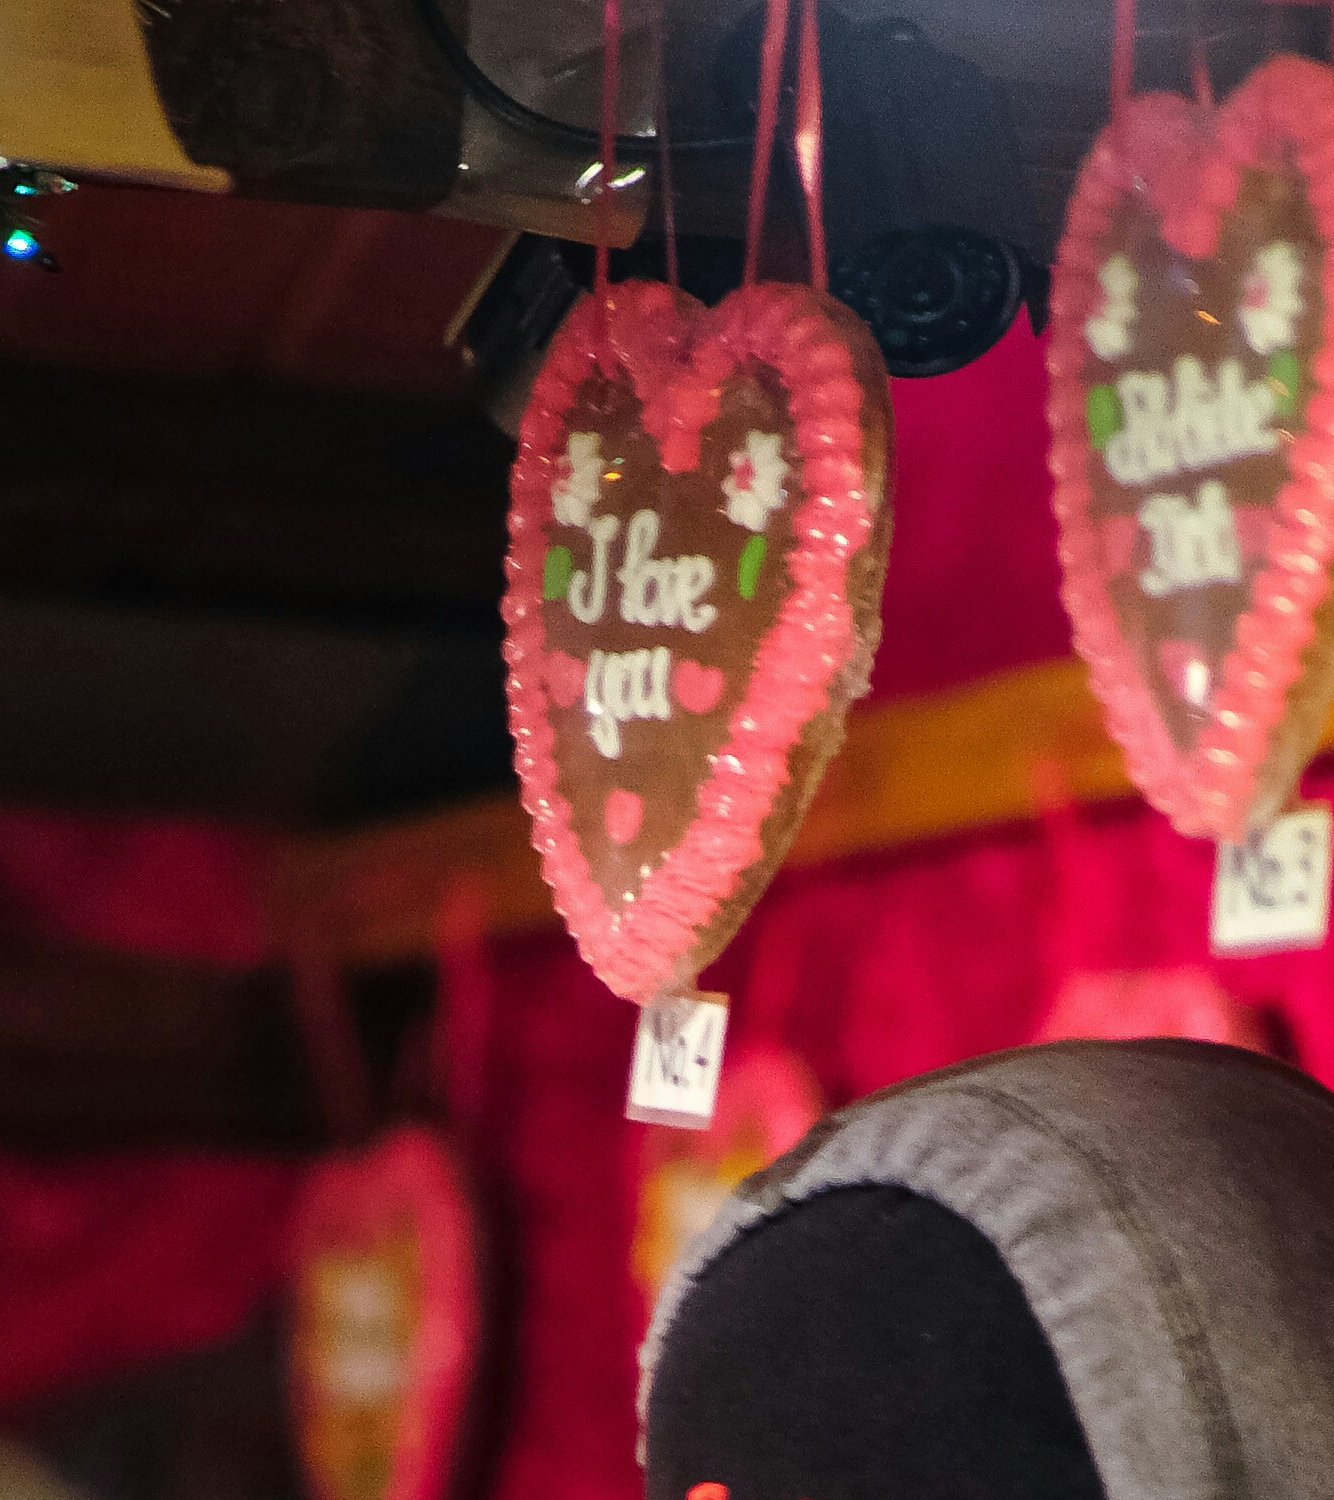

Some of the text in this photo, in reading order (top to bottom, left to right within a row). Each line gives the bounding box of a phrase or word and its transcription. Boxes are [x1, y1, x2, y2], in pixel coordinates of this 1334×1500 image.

[568, 508, 719, 634] I love
[584, 645, 672, 761] you
